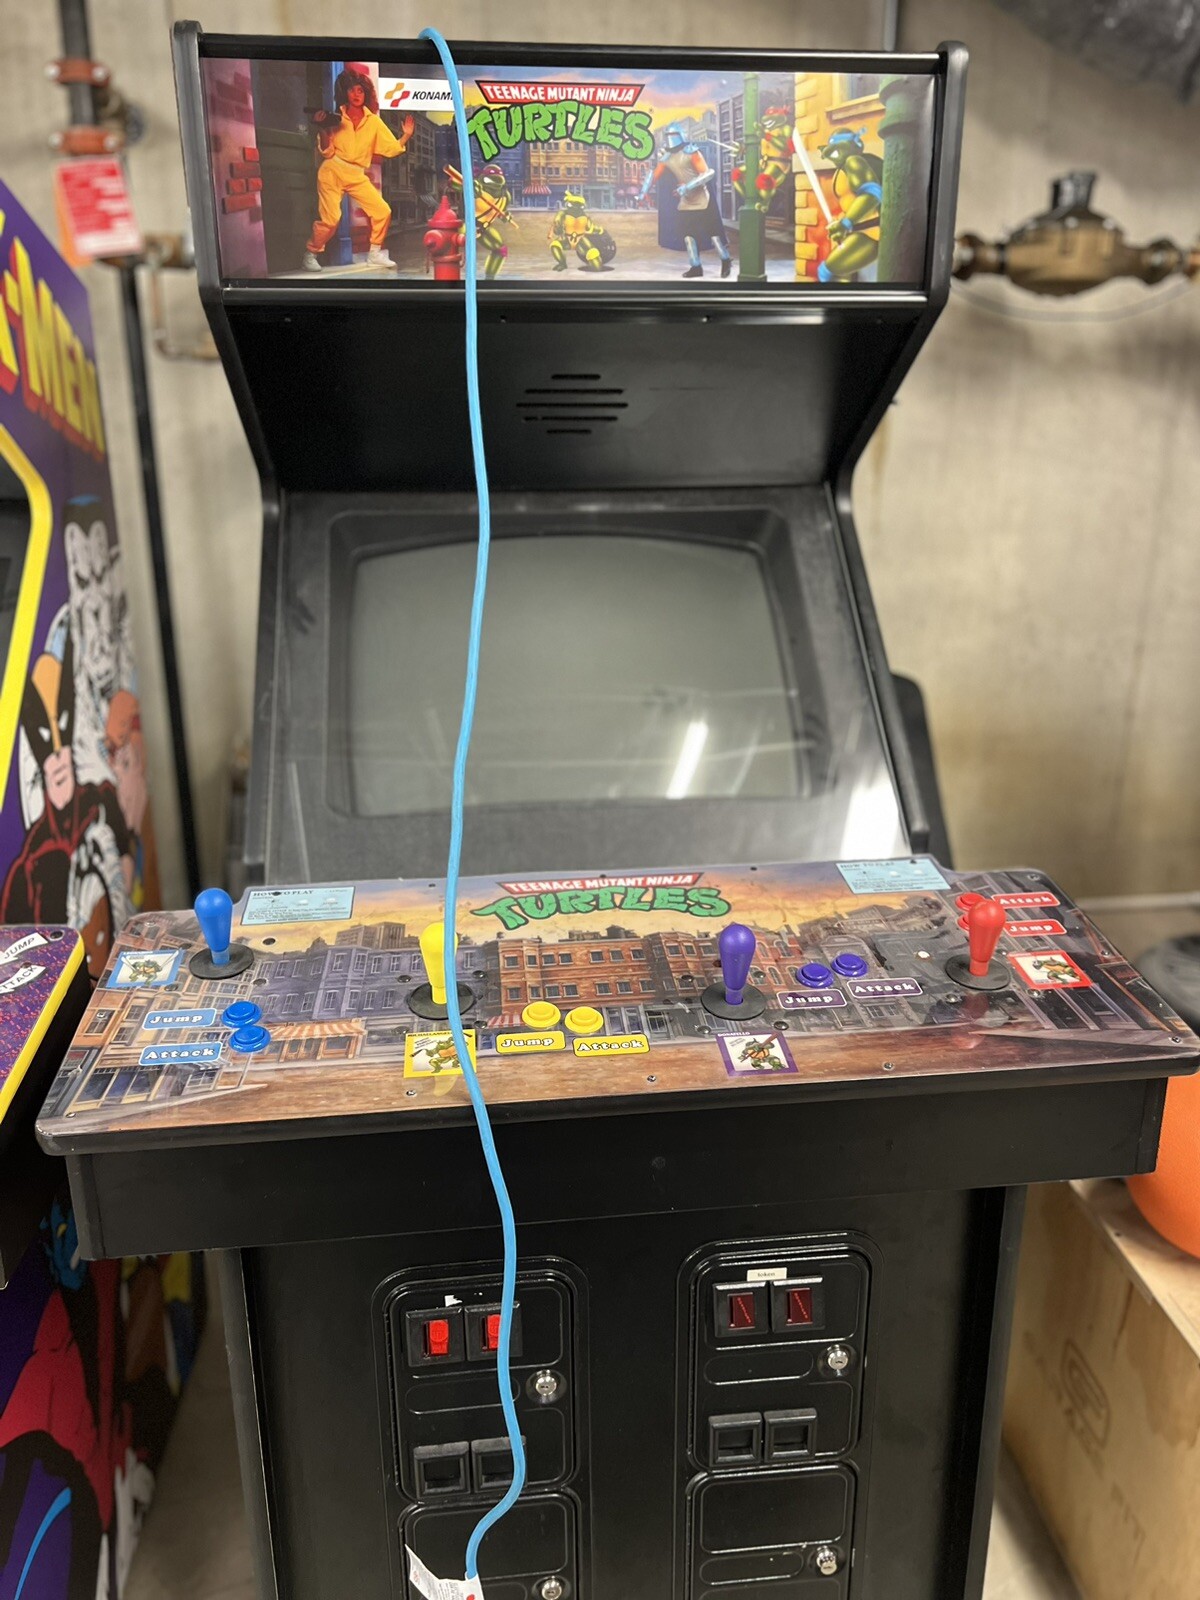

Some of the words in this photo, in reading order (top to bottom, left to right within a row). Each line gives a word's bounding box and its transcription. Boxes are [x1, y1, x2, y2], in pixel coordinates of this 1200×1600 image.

[484, 85, 545, 100] TEENAGE
[547, 86, 593, 101] MUTANT
[596, 87, 635, 102] NINJA
[467, 100, 655, 161] TURTLES
[508, 880, 582, 892] TEENAGE
[585, 877, 644, 889] MUTANT
[647, 874, 694, 885] NINJA
[1000, 896, 1053, 905] Attack
[470, 886, 731, 930] TURTLES
[4, 937, 35, 959] JUMP
[0, 966, 37, 989] TTACK
[854, 982, 916, 993] Attack
[785, 994, 833, 1004] Jump
[150, 1014, 204, 1024] Jump
[501, 1036, 555, 1048] Jump
[577, 1039, 645, 1051] Attack
[145, 1048, 215, 1060] Attack
